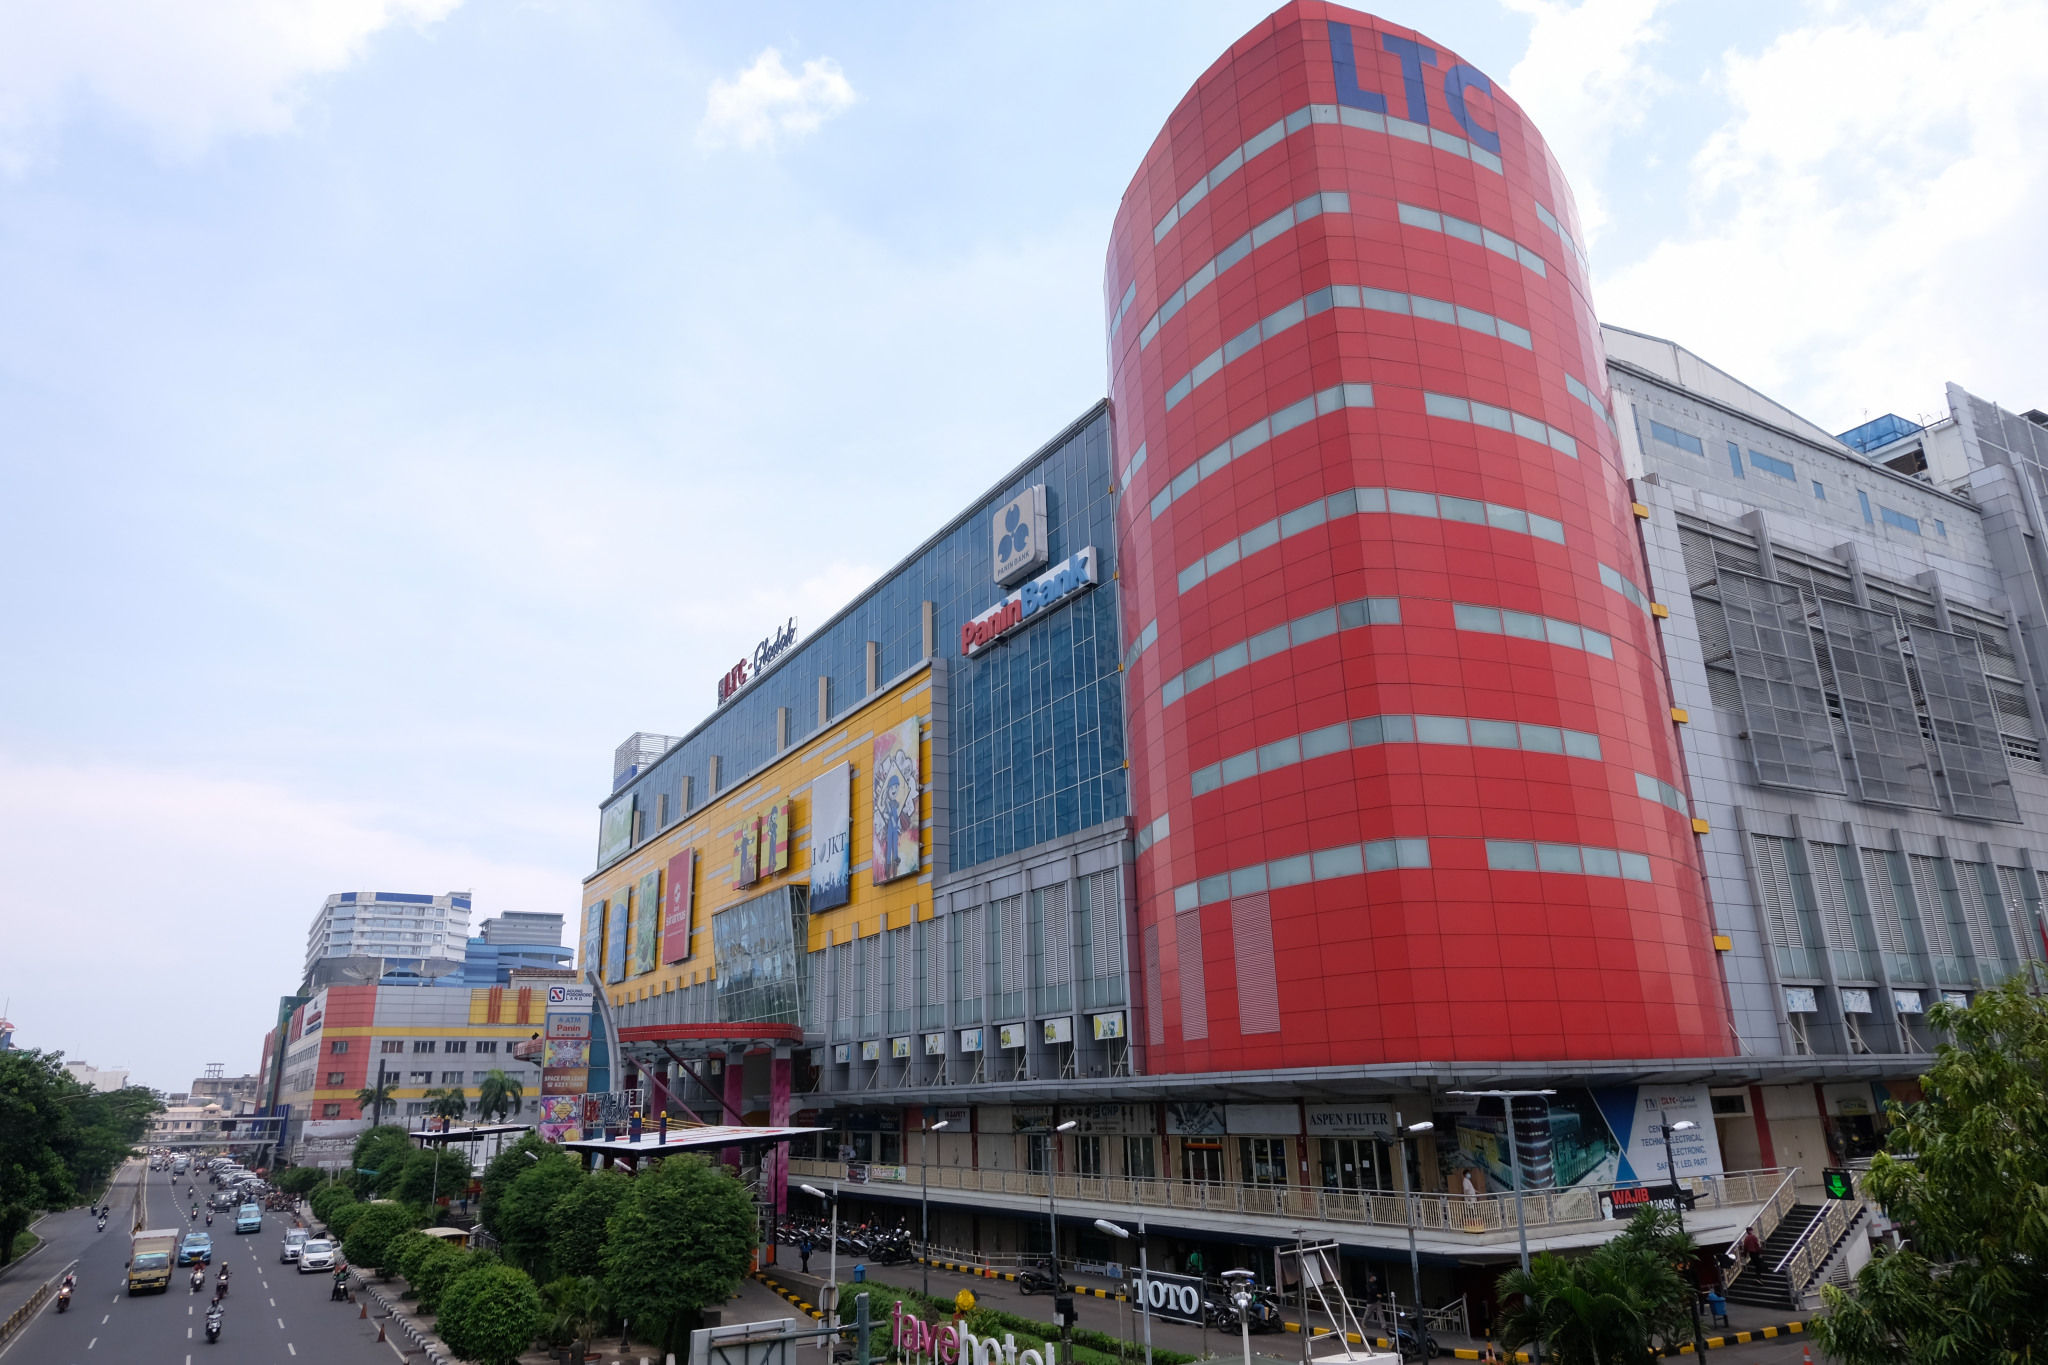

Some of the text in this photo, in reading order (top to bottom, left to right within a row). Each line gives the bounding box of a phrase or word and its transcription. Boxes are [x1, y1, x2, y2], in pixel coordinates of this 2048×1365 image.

[1327, 20, 1502, 153] LTC
[826, 832, 847, 863] JKT
[1310, 1111, 1388, 1126] ASPEN FILTER
[1611, 1187, 1650, 1205] WAJIB
[1132, 1279, 1199, 1315] TOTO
